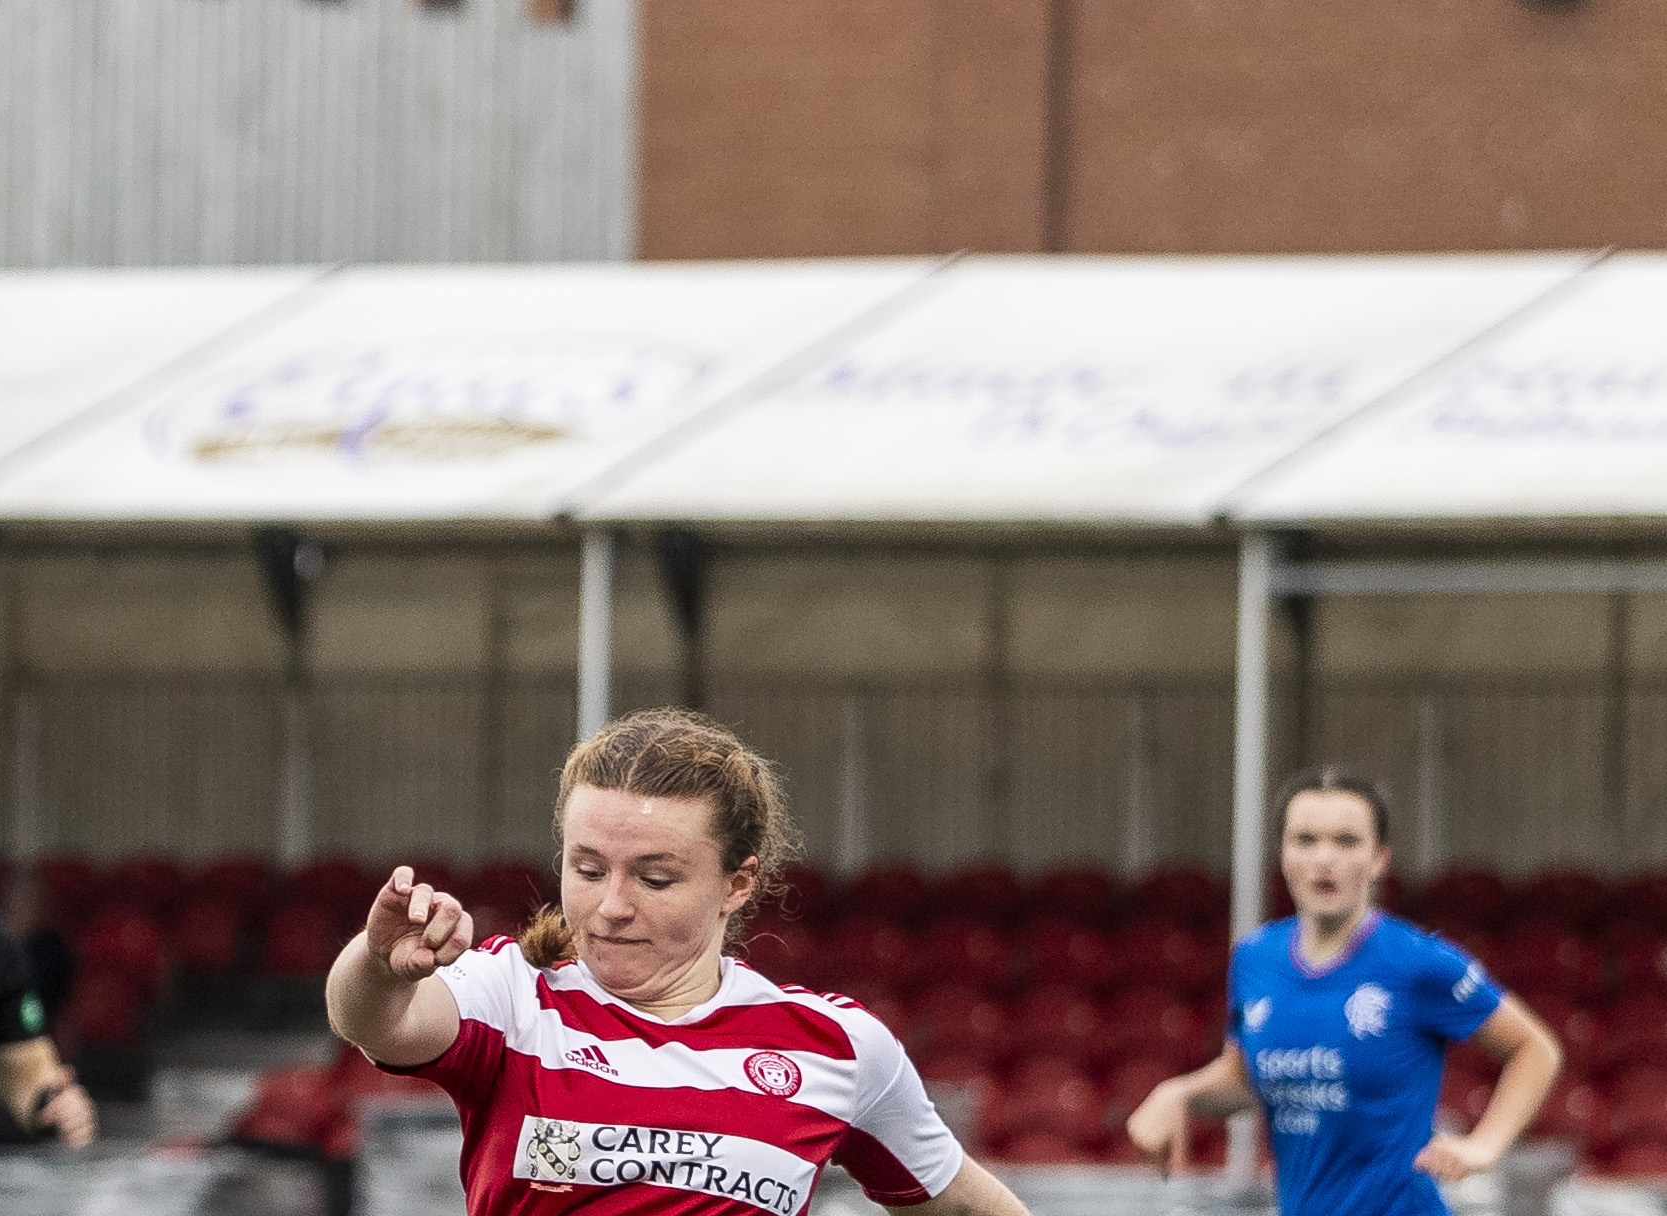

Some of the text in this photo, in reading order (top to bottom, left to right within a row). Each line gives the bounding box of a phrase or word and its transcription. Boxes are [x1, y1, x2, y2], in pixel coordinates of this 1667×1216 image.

[564, 1052, 620, 1077] adidas
[591, 1126, 724, 1159] CAREY
[589, 1157, 799, 1215] CONTRACTS
